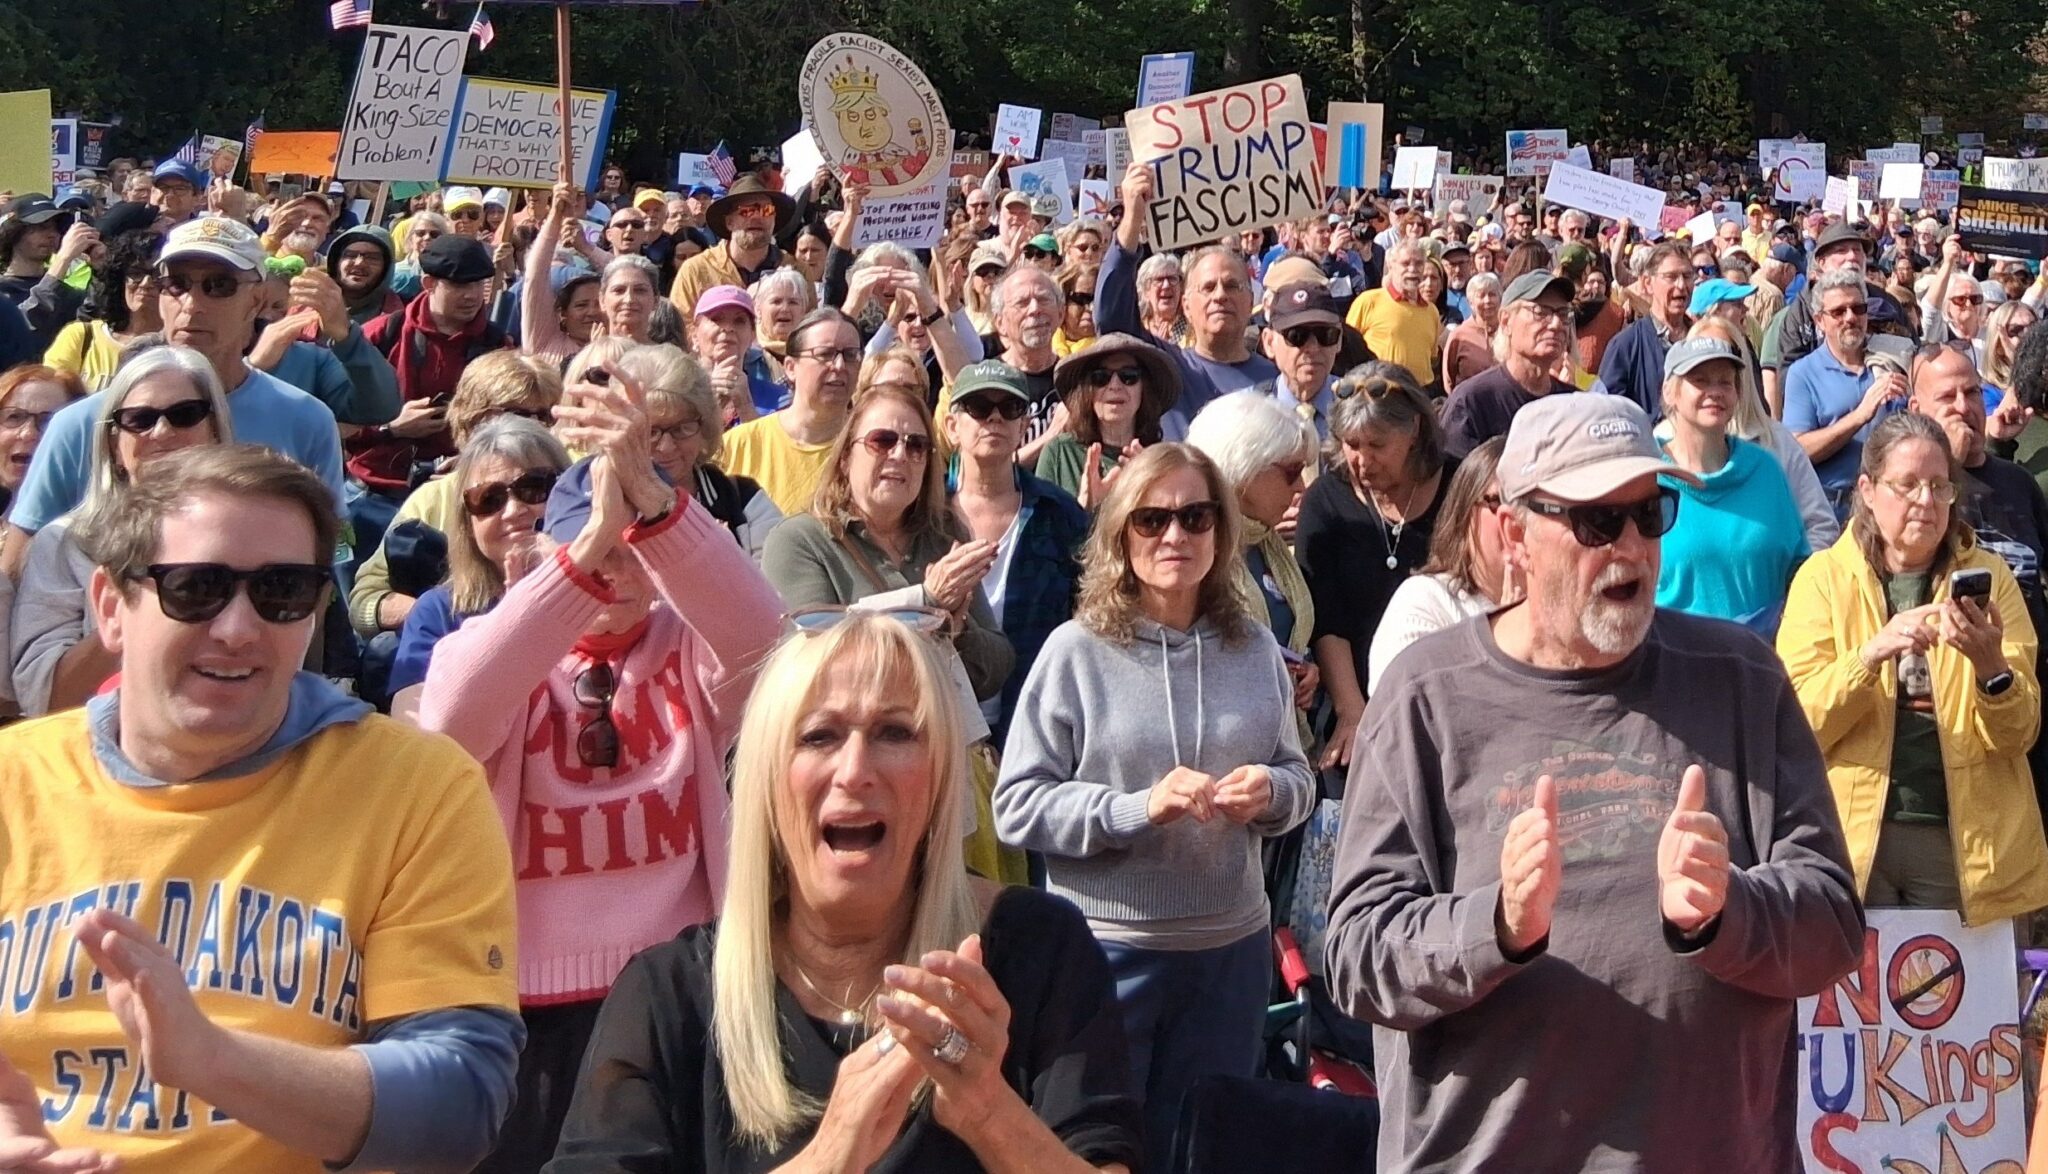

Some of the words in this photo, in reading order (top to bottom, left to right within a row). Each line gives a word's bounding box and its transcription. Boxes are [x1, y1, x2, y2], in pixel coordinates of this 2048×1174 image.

[369, 30, 460, 76] TACO
[804, 39, 836, 81] FRAGILE
[840, 36, 885, 53] RACIST
[887, 53, 926, 87] SEXIST
[425, 78, 440, 101] A
[488, 89, 529, 112] WE
[353, 102, 450, 139] King-Size
[802, 84, 820, 137] CALLOUS
[923, 91, 945, 124] NASTY
[1017, 110, 1033, 120] AM
[1152, 82, 1287, 149] STOP
[352, 136, 437, 166] Problem!
[457, 136, 510, 153] THAT'S
[518, 142, 552, 157] WHY
[559, 144, 584, 160] E
[1146, 121, 1306, 198] TRUMP
[472, 155, 575, 182] PROTES
[1989, 160, 2024, 177] TRUMP
[857, 204, 886, 216] STOP
[1150, 160, 1324, 248] FASCISM!
[1977, 199, 2019, 213] MIKIE
[861, 230, 870, 240] A
[1958, 208, 2048, 235] SHERRILL
[1600, 804, 1629, 816] PARK
[518, 775, 698, 881] HIM
[157, 880, 365, 1031] DAKOTA
[1811, 926, 1966, 1030] NO
[43, 1048, 236, 1132] STA
